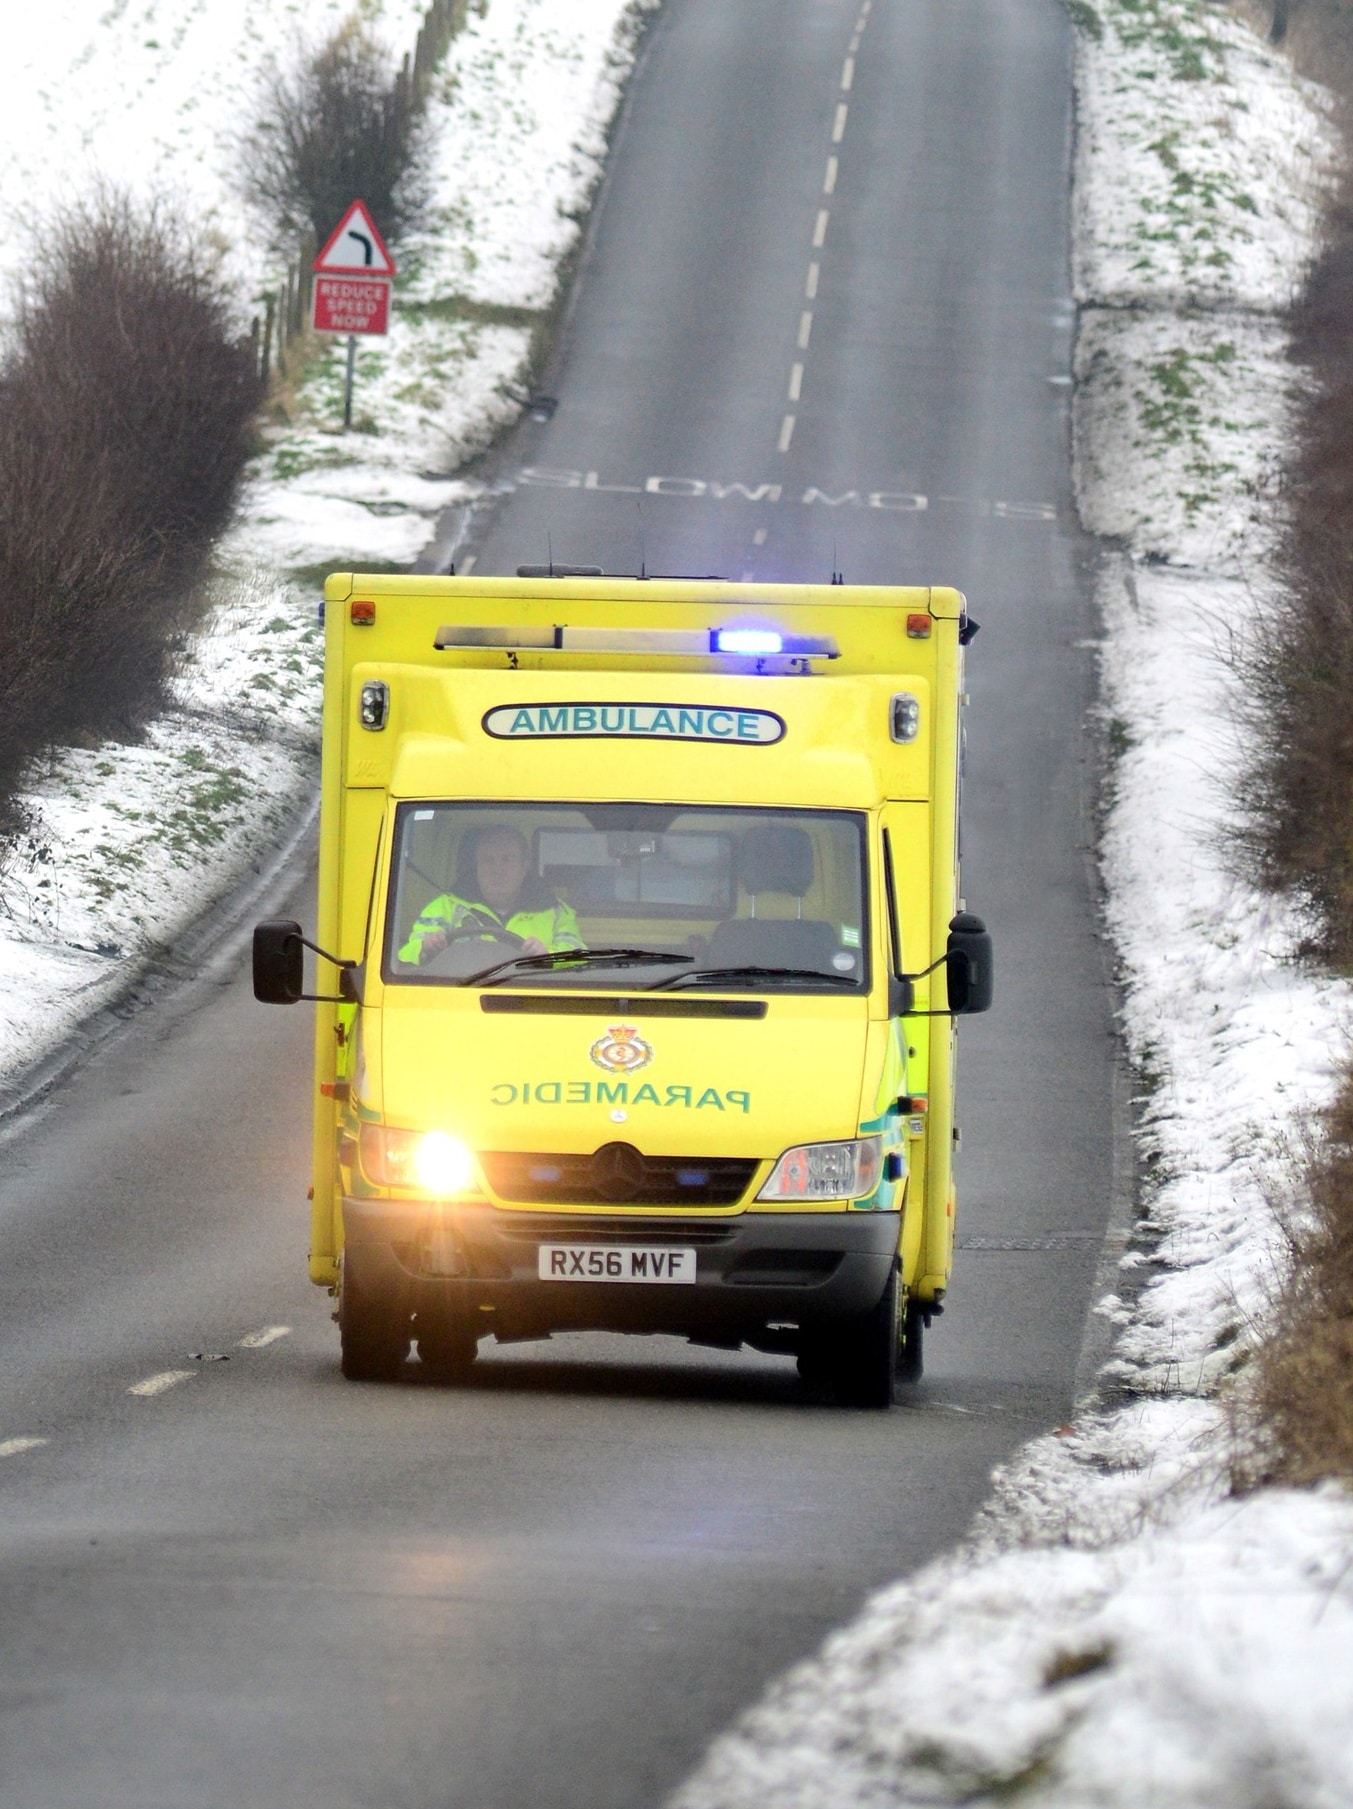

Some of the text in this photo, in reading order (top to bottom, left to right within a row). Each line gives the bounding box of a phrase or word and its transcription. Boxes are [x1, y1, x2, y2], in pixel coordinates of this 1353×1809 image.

[320, 281, 384, 301] REDUCE
[326, 297, 378, 316] SPEED
[330, 313, 370, 329] NOW
[516, 467, 783, 502] SLOW
[509, 707, 760, 739] AMBULANCE
[551, 1250, 684, 1278] RX56 MVF
